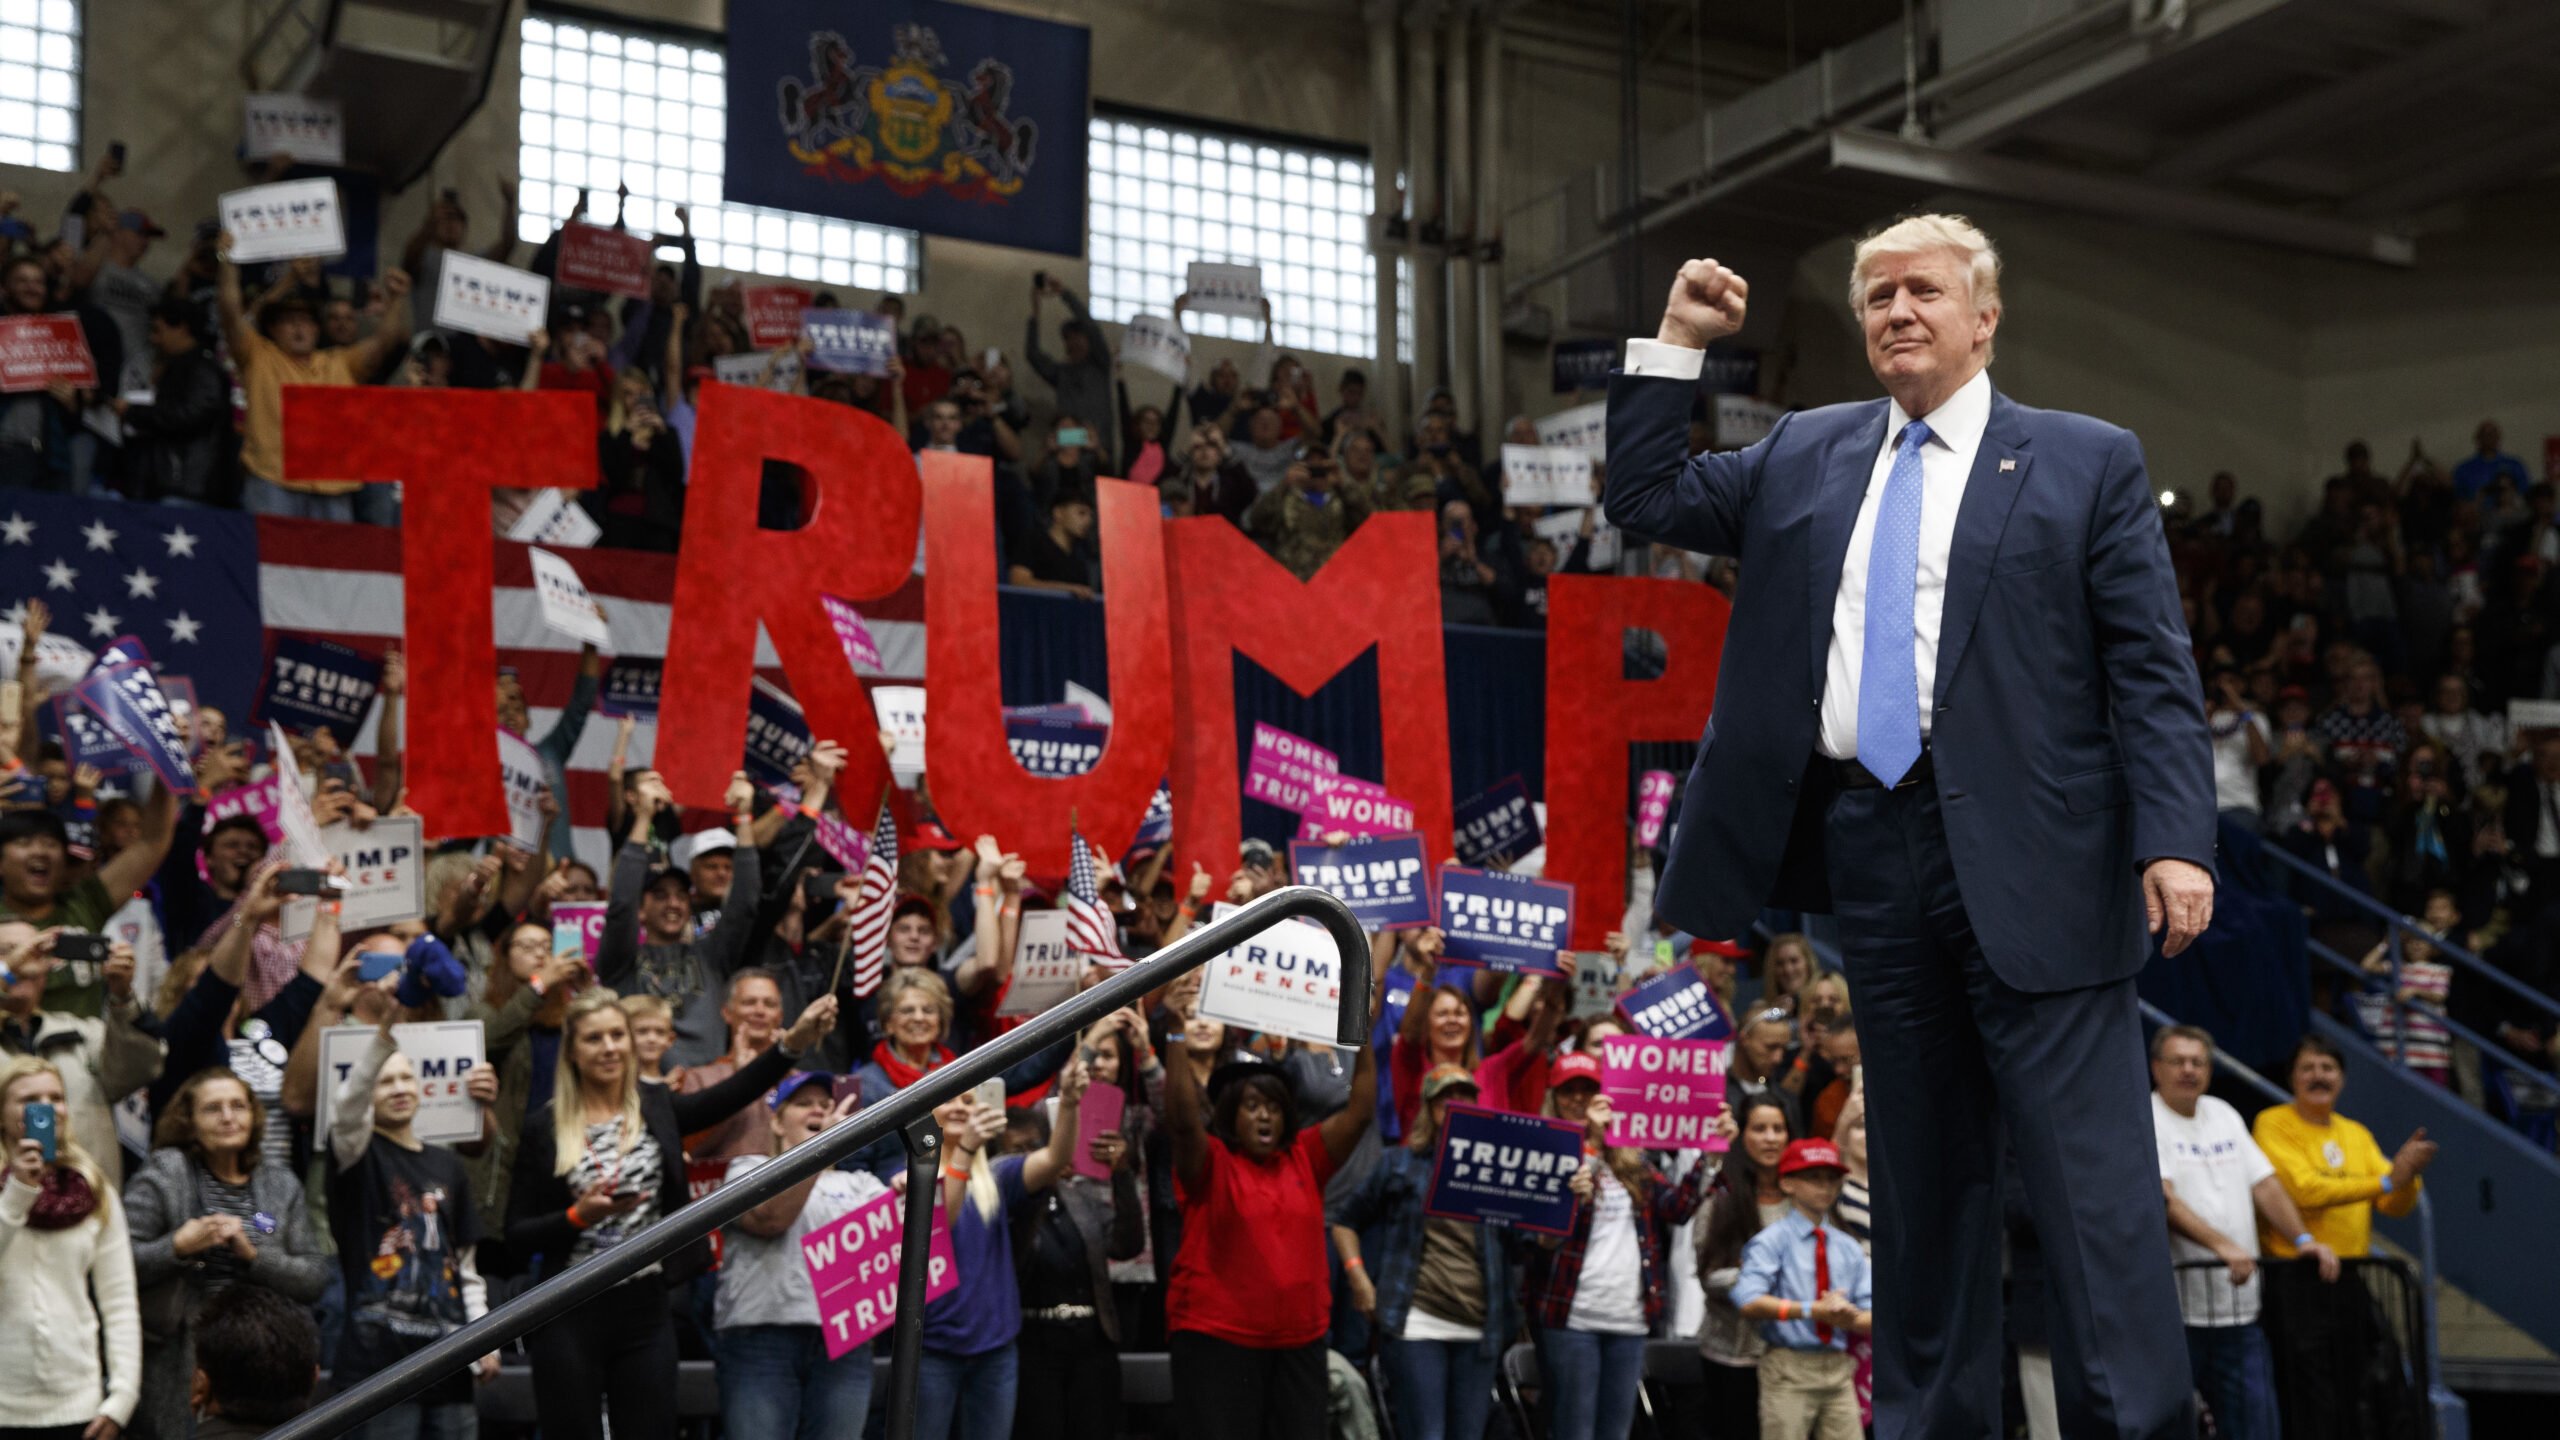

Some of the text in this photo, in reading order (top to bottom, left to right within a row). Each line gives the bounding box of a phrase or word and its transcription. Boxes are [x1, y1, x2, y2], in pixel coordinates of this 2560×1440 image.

[275, 656, 374, 700] TRUMP
[283, 383, 1733, 955] TRUMP
[1008, 739, 1100, 761] TRUMP
[1255, 728, 1338, 774] WOMEN
[1328, 794, 1413, 831] WOMEN
[1454, 796, 1525, 848] RUMP
[1298, 858, 1420, 886] TRUMP
[1312, 879, 1412, 899] ENCE
[1444, 891, 1567, 926] TRUMP
[1453, 914, 1555, 941] PENCE
[1230, 966, 1339, 1000] PENCE
[1633, 981, 1707, 1030] TRUMP
[1604, 1042, 1726, 1076] WOMEN
[1645, 1082, 1691, 1104] FOR
[1611, 1110, 1719, 1142] TRUMP
[1449, 1137, 1580, 1177] TRUMP
[1454, 1162, 1563, 1192] PENCE
[830, 1256, 947, 1341] TRUP
